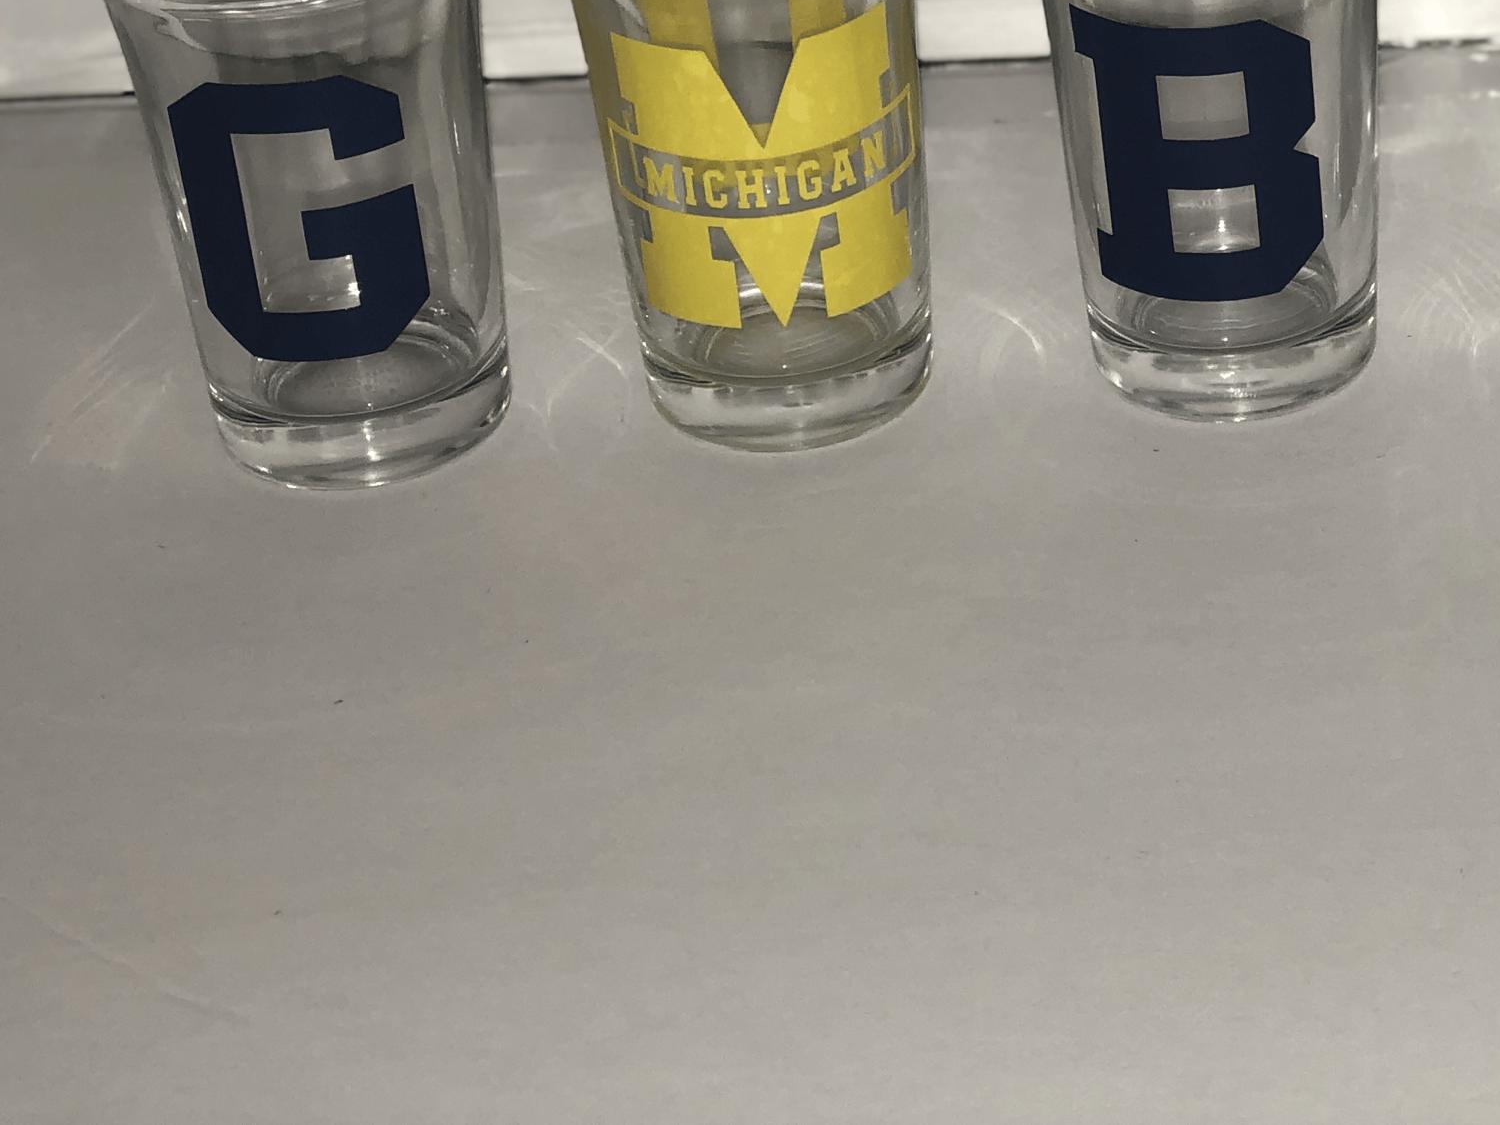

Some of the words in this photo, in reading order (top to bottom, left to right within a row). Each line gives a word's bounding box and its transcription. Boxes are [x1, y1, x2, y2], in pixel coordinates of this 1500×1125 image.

[169, 75, 428, 362] G
[642, 130, 888, 209] MICHIGAN
[1070, 4, 1324, 302] B
